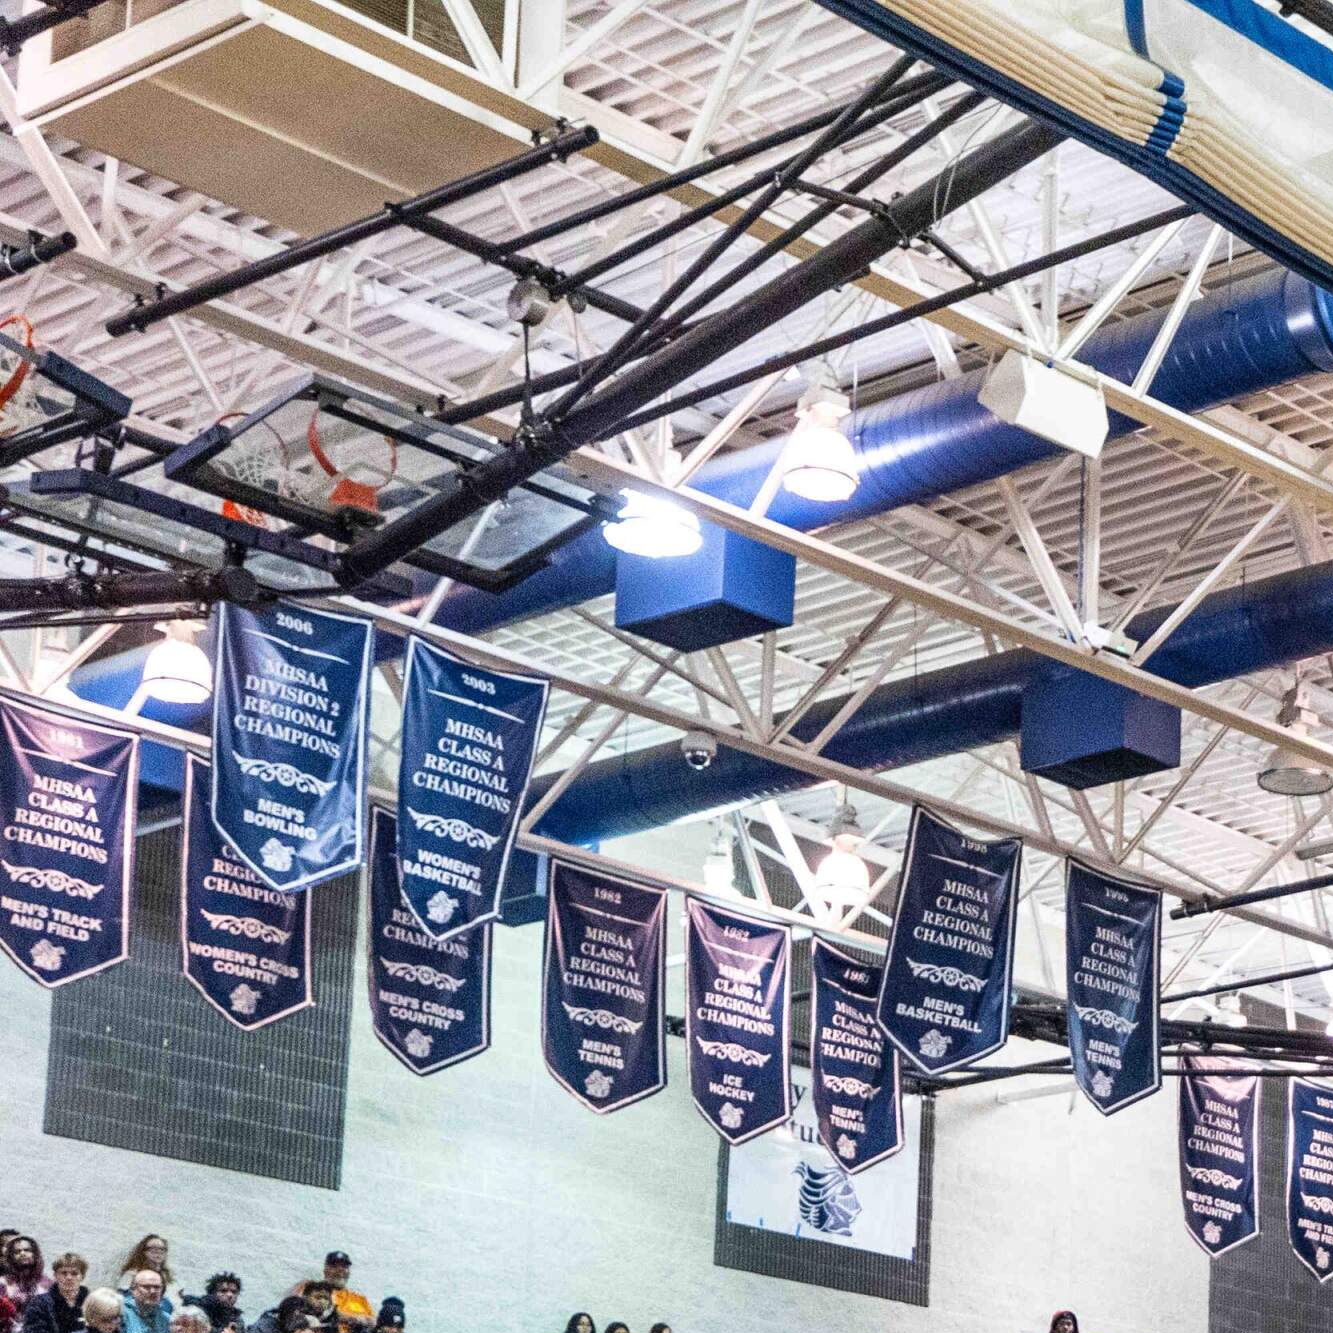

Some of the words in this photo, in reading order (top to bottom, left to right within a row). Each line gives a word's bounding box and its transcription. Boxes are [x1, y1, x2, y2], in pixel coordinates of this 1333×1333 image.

[265, 661, 328, 692] MHSAA
[244, 674, 329, 711] DIVISION
[330, 702, 340, 716] 2
[243, 695, 336, 737] REGIONAL
[234, 714, 340, 759] CHAMPIONS
[445, 719, 504, 750] MHSAA
[438, 737, 491, 766] CLASS
[492, 756, 504, 771] A
[424, 753, 509, 793] REGIONAL
[32, 775, 97, 803] MHSAA
[413, 771, 511, 814] CHAMPIONS
[28, 792, 84, 818] CLASS
[85, 807, 99, 823] A
[258, 798, 305, 824] MEN'S
[15, 807, 104, 843] REGIONAL
[243, 809, 318, 842] BOWLING
[4, 825, 108, 864] CHAMPIONS
[402, 859, 482, 896] BASKETBALL
[417, 849, 482, 880] WOMEN'S
[943, 879, 990, 904] MHSAA
[935, 895, 979, 919] CLASS
[980, 909, 989, 922] A
[11, 913, 45, 930] AND
[47, 918, 90, 941] FIELD
[584, 925, 633, 951] MHSAA
[922, 910, 993, 941] REGIONAL
[1095, 926, 1134, 950] MHSAA
[580, 942, 624, 963] CLASS
[625, 954, 636, 968] A
[913, 925, 994, 960] CHAMPIONS
[569, 956, 641, 985] REGIONAL
[1081, 956, 1139, 985] REGIONAL
[563, 971, 646, 1003] CHAMPIONS
[704, 992, 772, 1020] REGIONAL
[896, 1003, 982, 1034] BASKETBALL
[923, 996, 965, 1016] MEN'S
[696, 1007, 775, 1036] CHAMPIONS
[578, 1049, 624, 1070] TENNIS
[708, 1081, 755, 1102] HOCKEY
[723, 1073, 743, 1088] ICE
[1200, 1112, 1231, 1130] CLASS
[1205, 1099, 1239, 1119] MHSAA
[1187, 1137, 1245, 1164] CHAMPIONS
[1193, 1124, 1243, 1149] REGIONAL
[1192, 1203, 1233, 1221] COUNTRY
